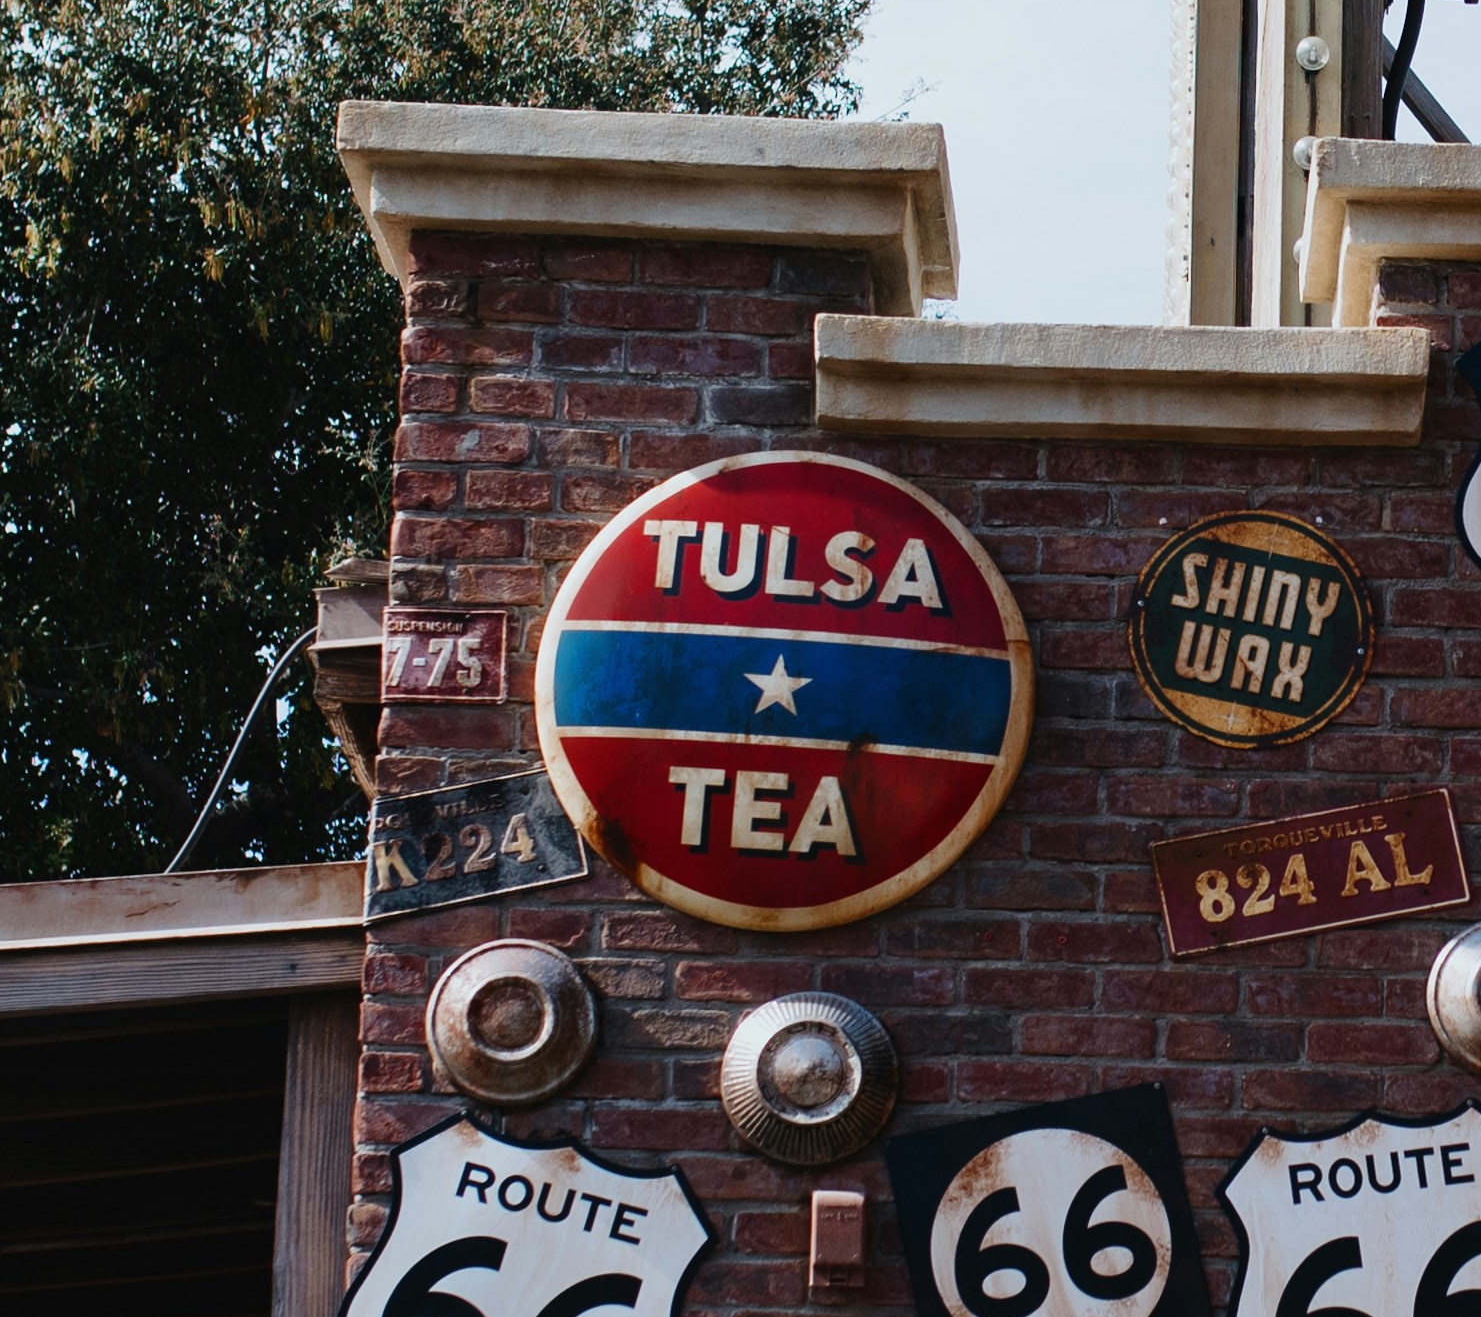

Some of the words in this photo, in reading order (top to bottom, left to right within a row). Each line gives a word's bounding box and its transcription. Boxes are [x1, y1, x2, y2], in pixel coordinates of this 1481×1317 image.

[642, 518, 944, 610] TULSA
[1171, 551, 1341, 637] SHINY
[1174, 620, 1313, 703] WAX
[669, 765, 858, 857] TEA
[1223, 815, 1388, 859] TORQUEVILLE
[1195, 852, 1317, 923] 824
[1341, 832, 1434, 897] AL
[455, 1161, 650, 1246] ROUTE
[1289, 1142, 1477, 1205] ROUTE
